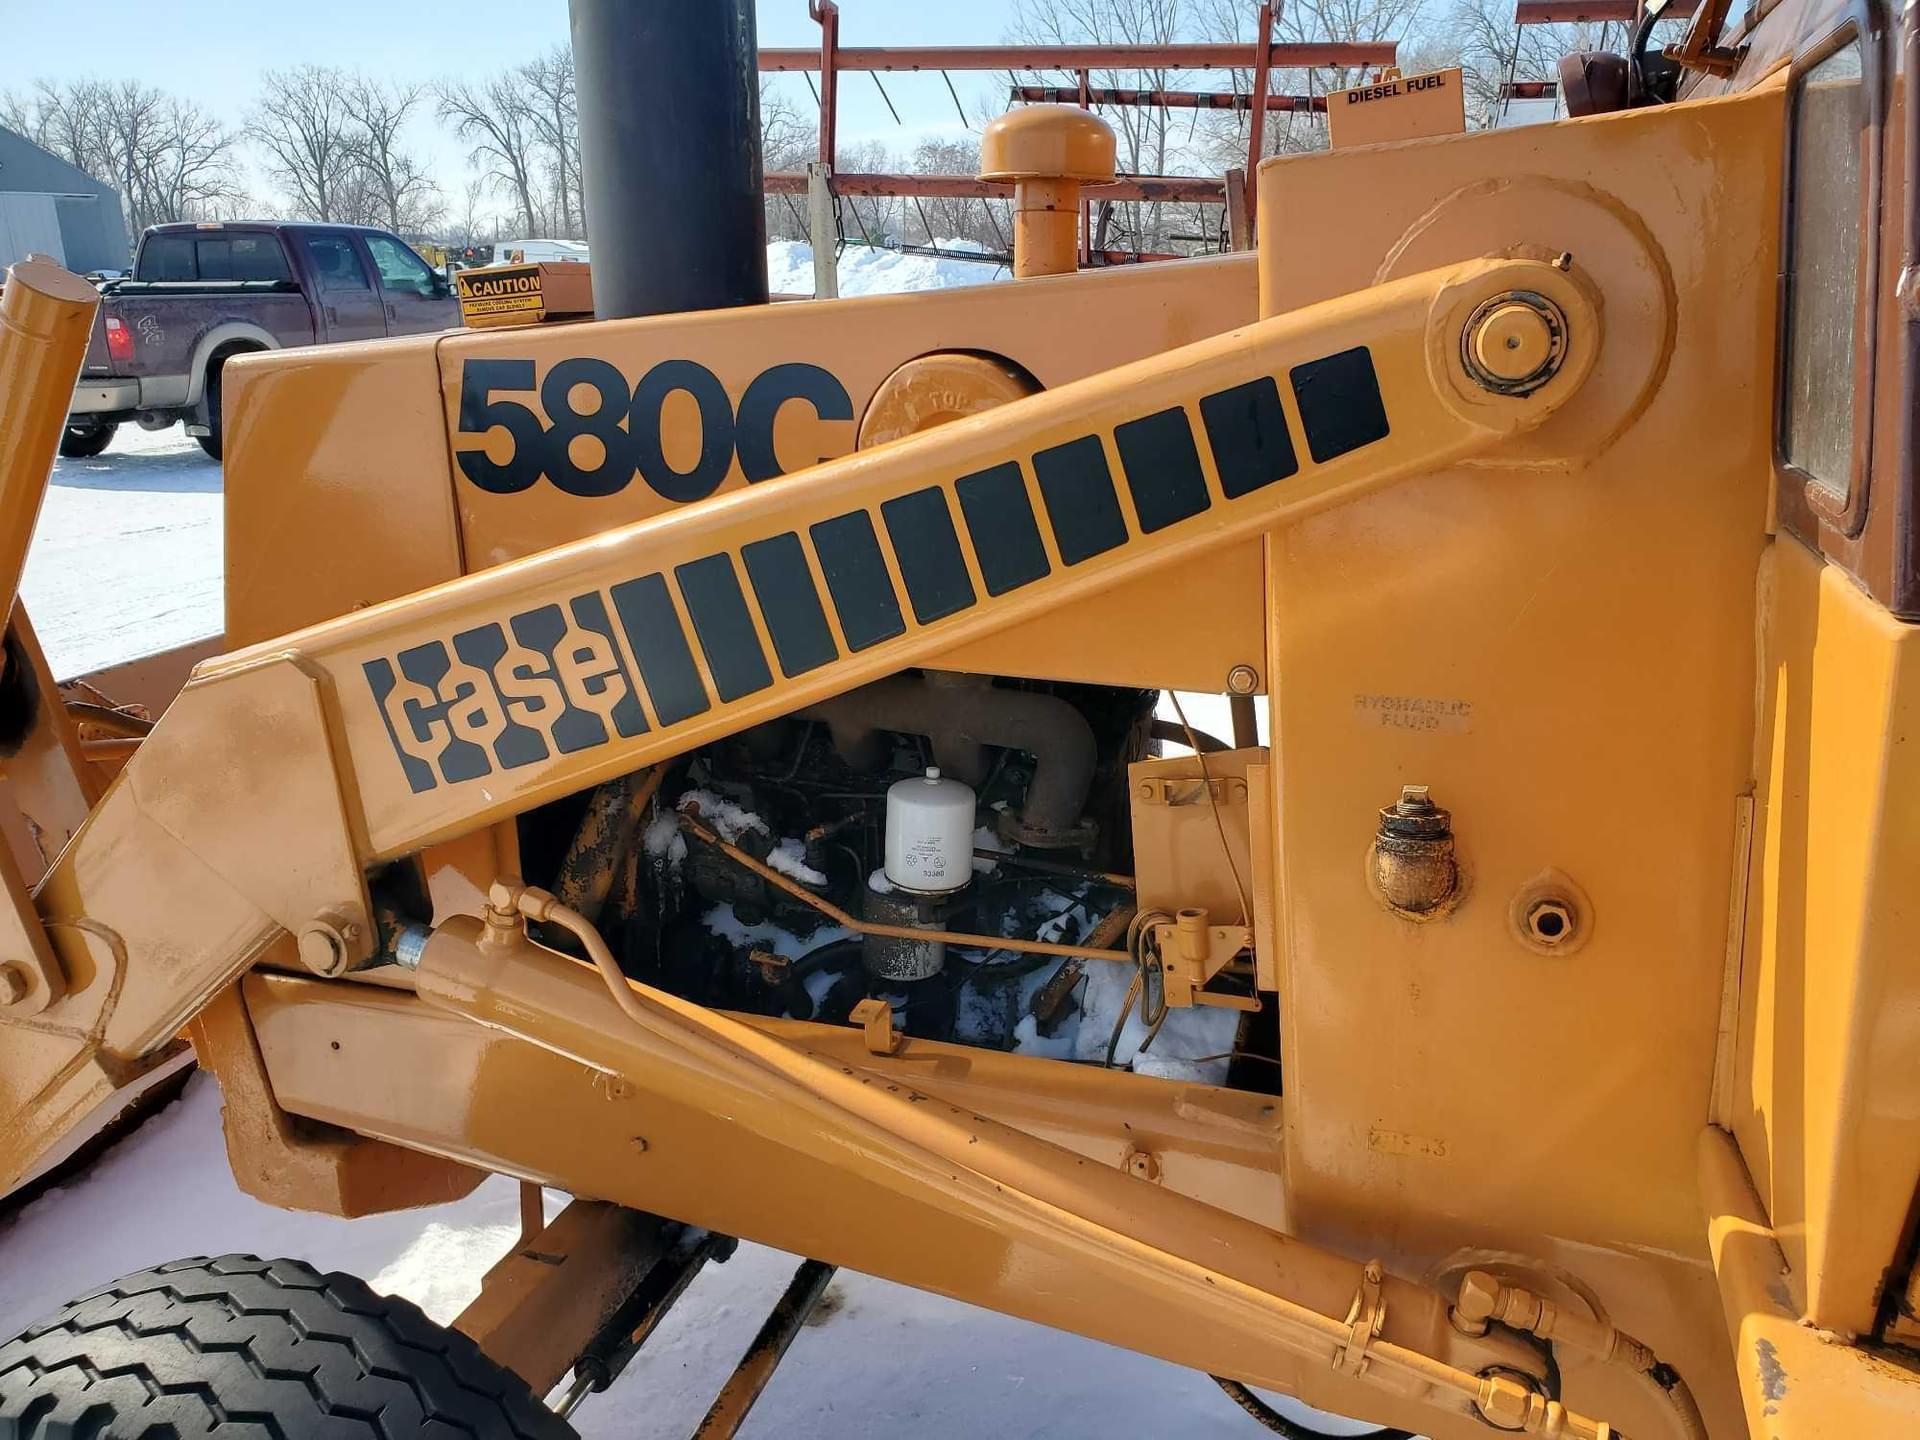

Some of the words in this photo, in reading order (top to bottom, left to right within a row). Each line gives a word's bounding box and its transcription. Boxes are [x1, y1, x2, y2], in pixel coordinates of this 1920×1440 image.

[1348, 84, 1401, 104] DIESEL
[1406, 75, 1445, 93] FUEL
[472, 276, 541, 296] CAUTION
[455, 357, 854, 503] 580C
[1355, 694, 1470, 715] HYDRAULIC
[1382, 711, 1438, 730] FLUID
